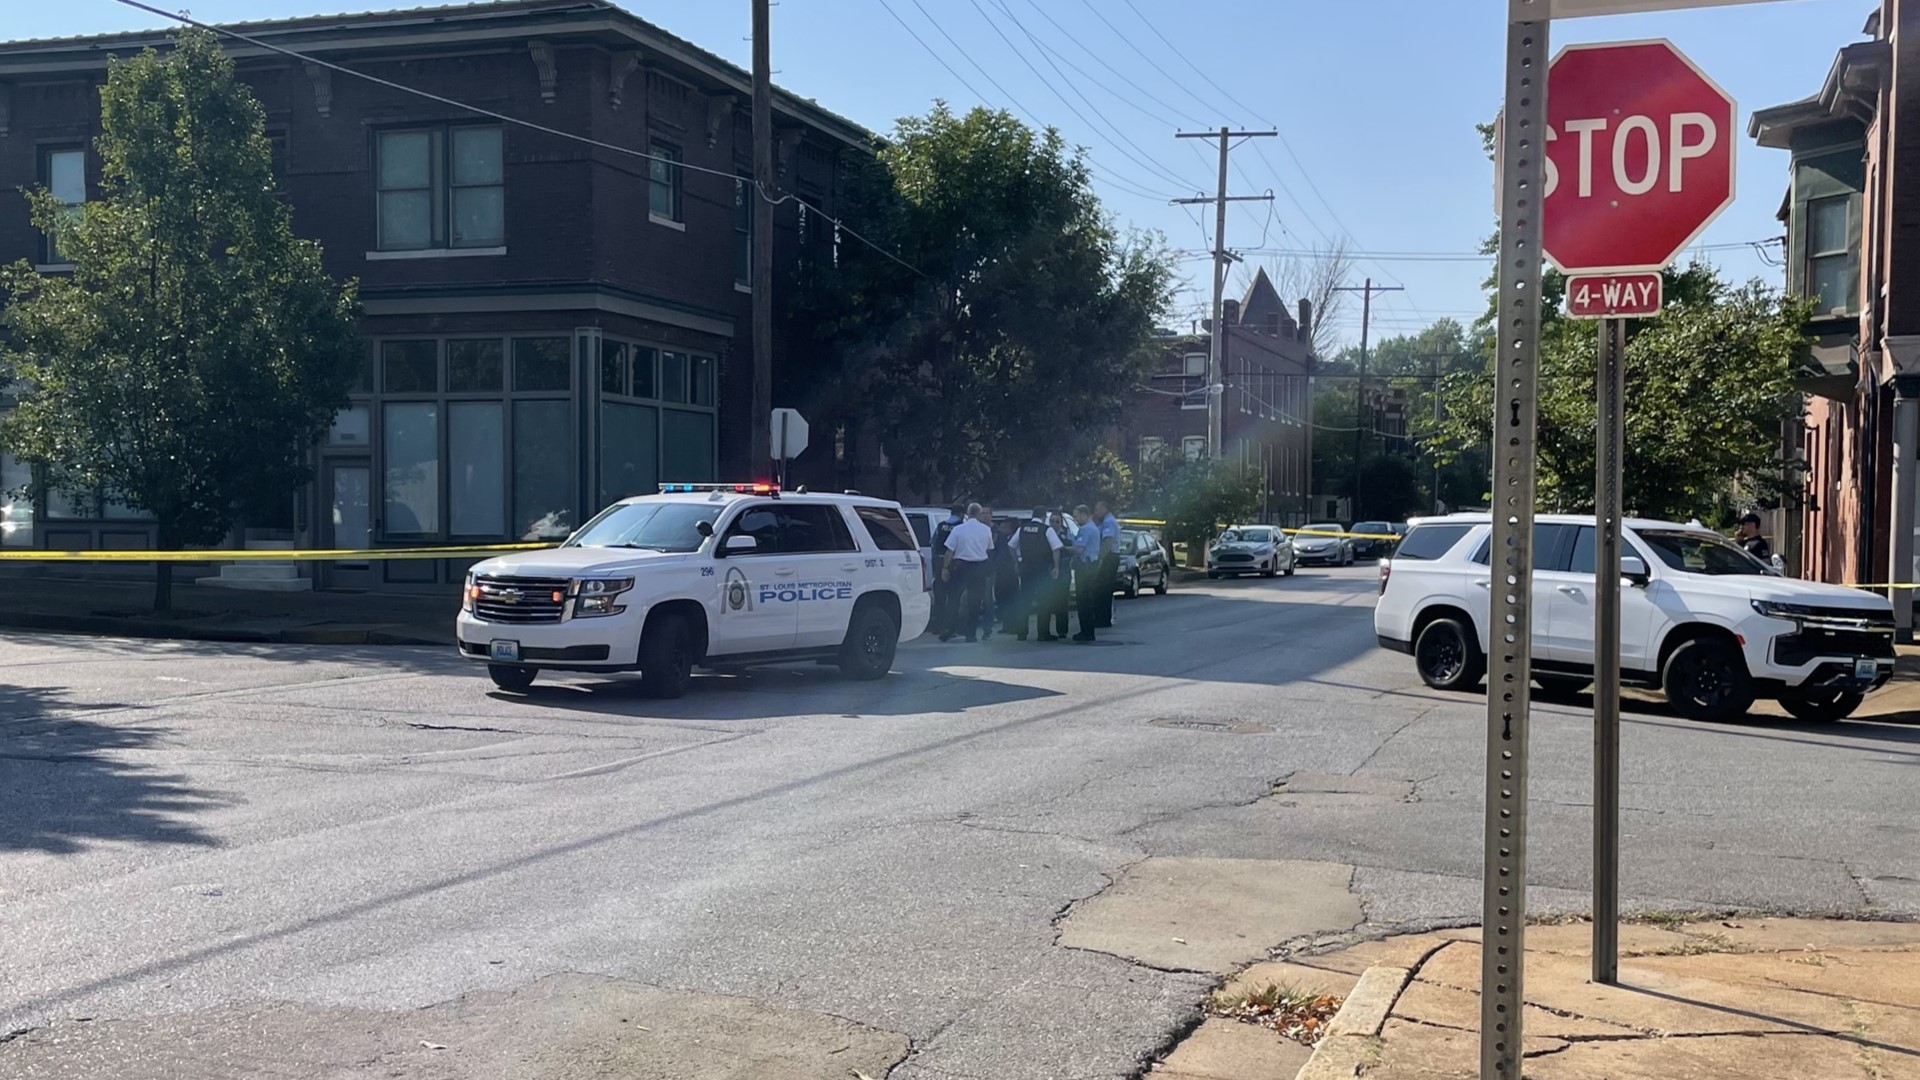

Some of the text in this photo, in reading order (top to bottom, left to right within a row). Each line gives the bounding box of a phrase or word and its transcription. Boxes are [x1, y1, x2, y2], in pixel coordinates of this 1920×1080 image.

[1575, 282, 1653, 309] 4-WAY
[701, 566, 714, 577] 296
[774, 583, 796, 591] LOUIS
[798, 581, 852, 589] METROPOLITAN
[760, 588, 852, 603] POLICE
